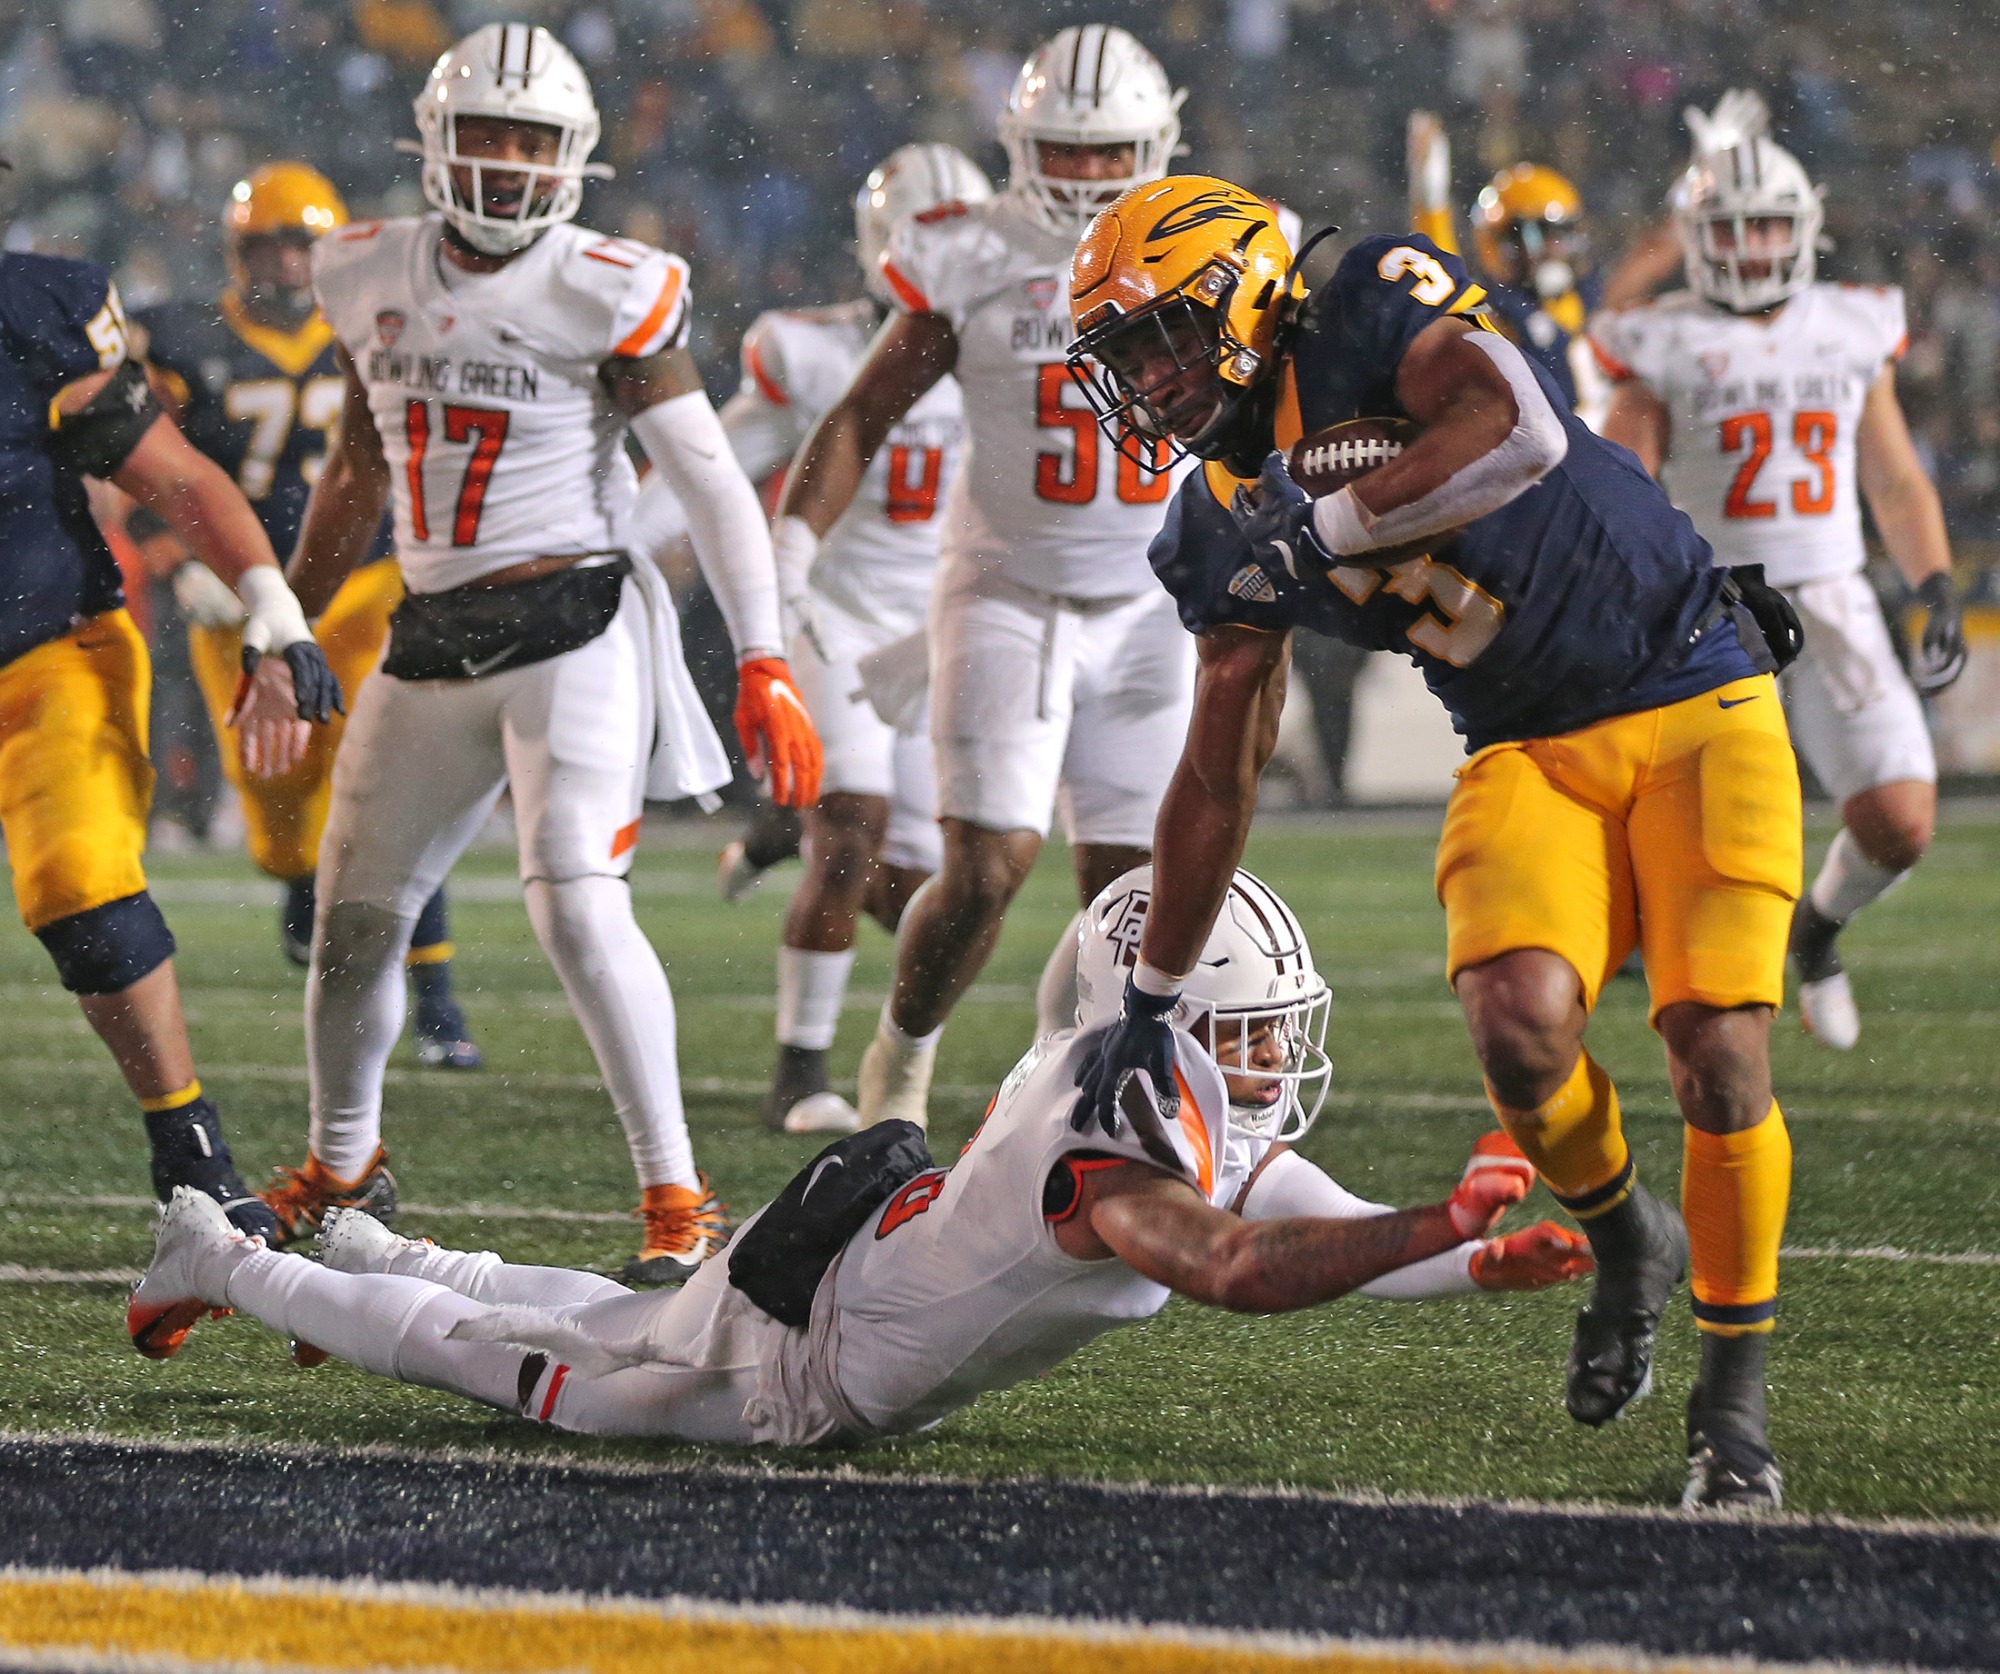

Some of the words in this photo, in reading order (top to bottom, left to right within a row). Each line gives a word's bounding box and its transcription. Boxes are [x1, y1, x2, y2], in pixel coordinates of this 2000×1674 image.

[1377, 246, 1456, 306] 3
[460, 359, 538, 399] GREEN
[405, 399, 510, 547] 17
[1720, 411, 1837, 519] 23
[1327, 553, 1505, 668] 3
